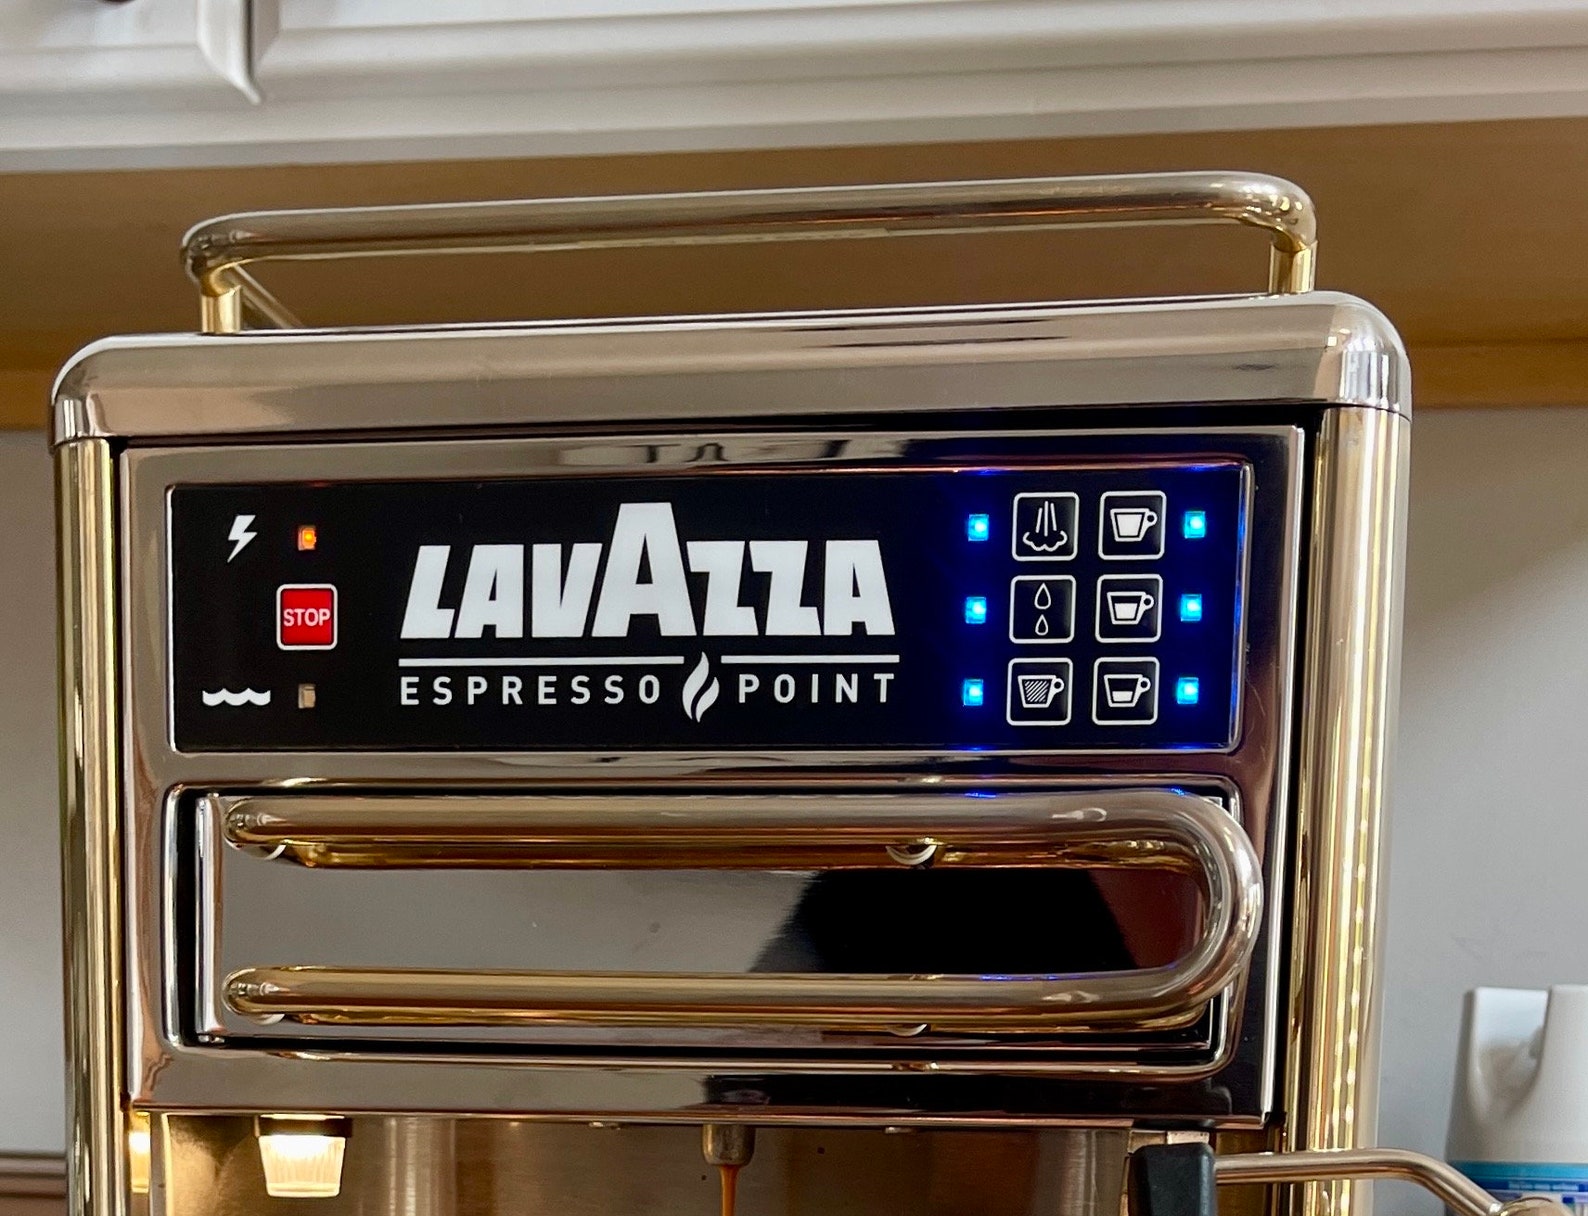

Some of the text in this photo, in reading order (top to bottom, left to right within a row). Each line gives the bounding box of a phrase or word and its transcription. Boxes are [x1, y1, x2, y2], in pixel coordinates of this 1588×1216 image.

[401, 503, 895, 638] LAVAZZA
[283, 608, 331, 627] STOP
[401, 674, 894, 705] ESPRESSO POINT
